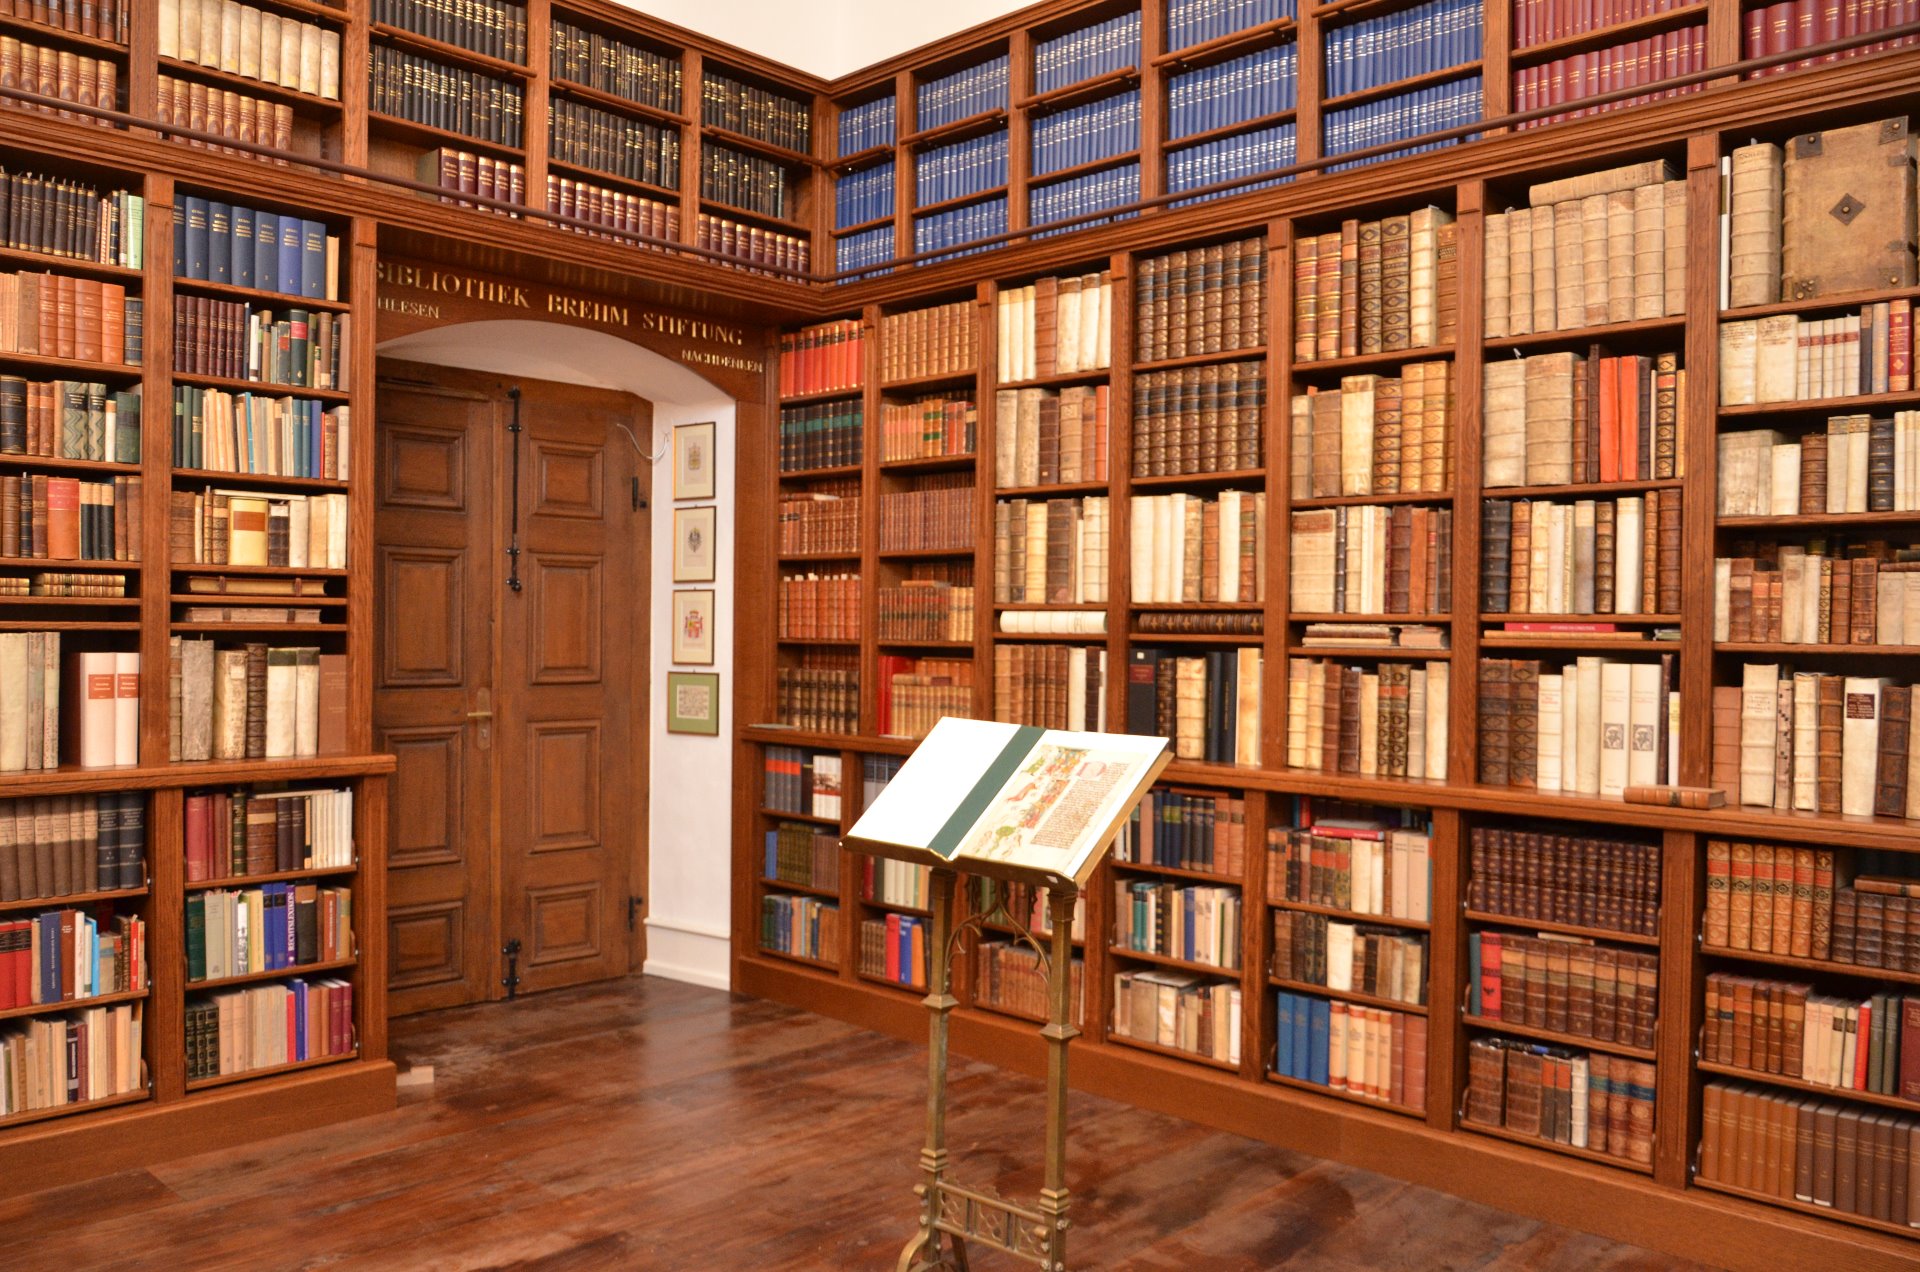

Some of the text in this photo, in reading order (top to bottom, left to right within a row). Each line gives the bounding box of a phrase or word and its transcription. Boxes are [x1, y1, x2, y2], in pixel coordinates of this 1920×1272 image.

[548, 294, 629, 326] BREHM
[643, 312, 743, 345] STIFTUNG
[682, 349, 764, 373] NACHDENKEN
[287, 891, 295, 952] RECHTSLEXIKON
